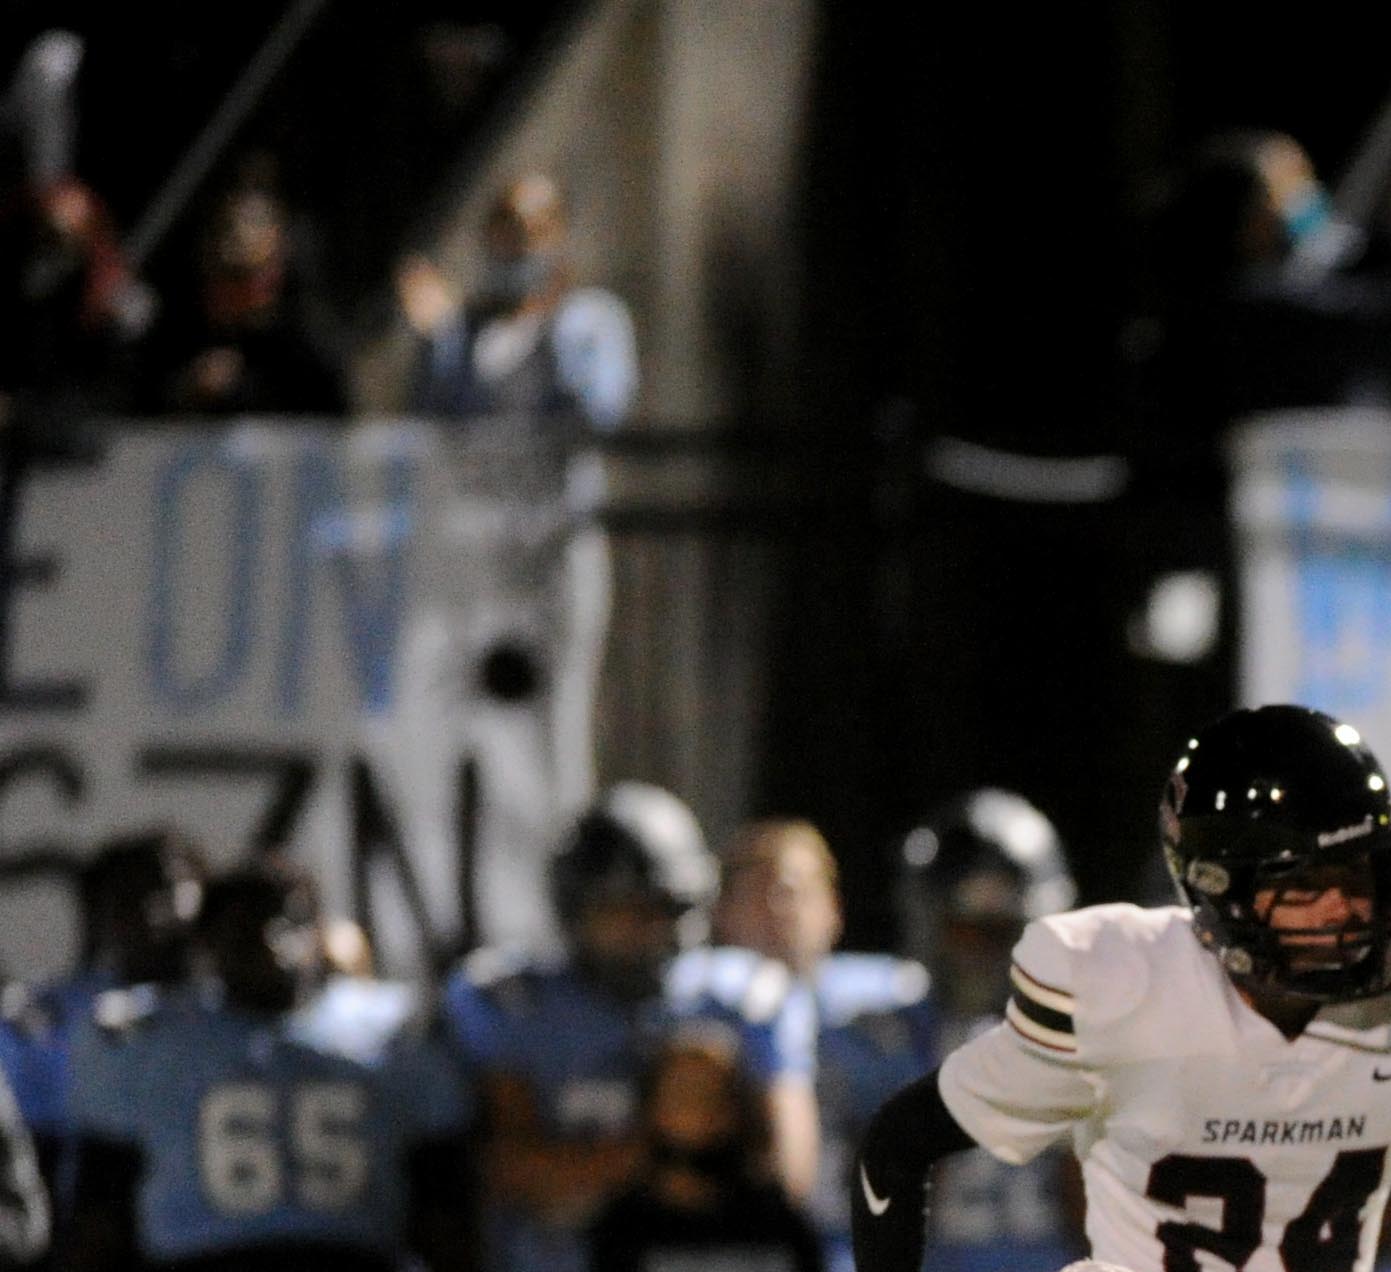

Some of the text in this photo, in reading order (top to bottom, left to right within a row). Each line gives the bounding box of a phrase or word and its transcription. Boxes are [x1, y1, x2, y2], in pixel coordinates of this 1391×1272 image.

[146, 440, 417, 717] ON
[201, 1081, 371, 1212] 65
[1202, 1115, 1367, 1144] SPARKMAN
